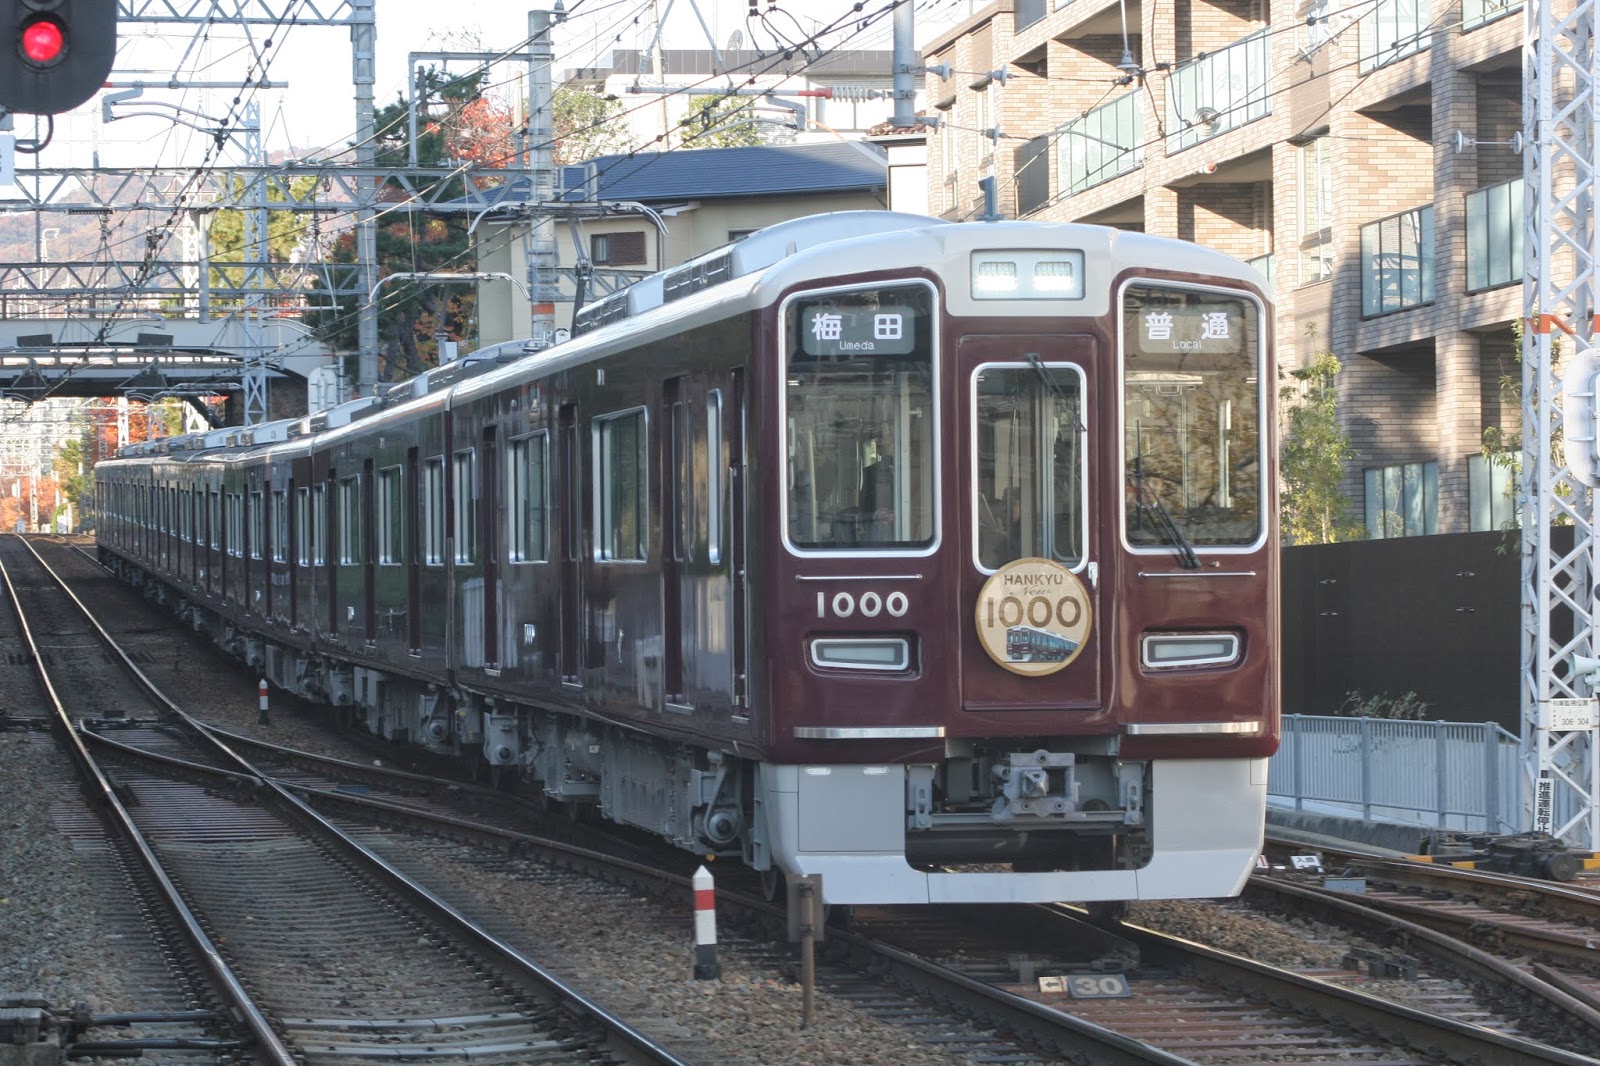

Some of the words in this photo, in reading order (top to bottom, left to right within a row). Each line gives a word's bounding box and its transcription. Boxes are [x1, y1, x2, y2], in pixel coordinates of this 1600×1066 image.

[811, 312, 902, 341] 梅田
[1145, 311, 1230, 340] 普通
[839, 340, 875, 351] Umeda
[1172, 339, 1202, 350] Local
[1003, 573, 1063, 586] HANKYU
[817, 591, 909, 618] 1000
[987, 595, 1082, 628] 1000
[1075, 977, 1122, 995] 30
